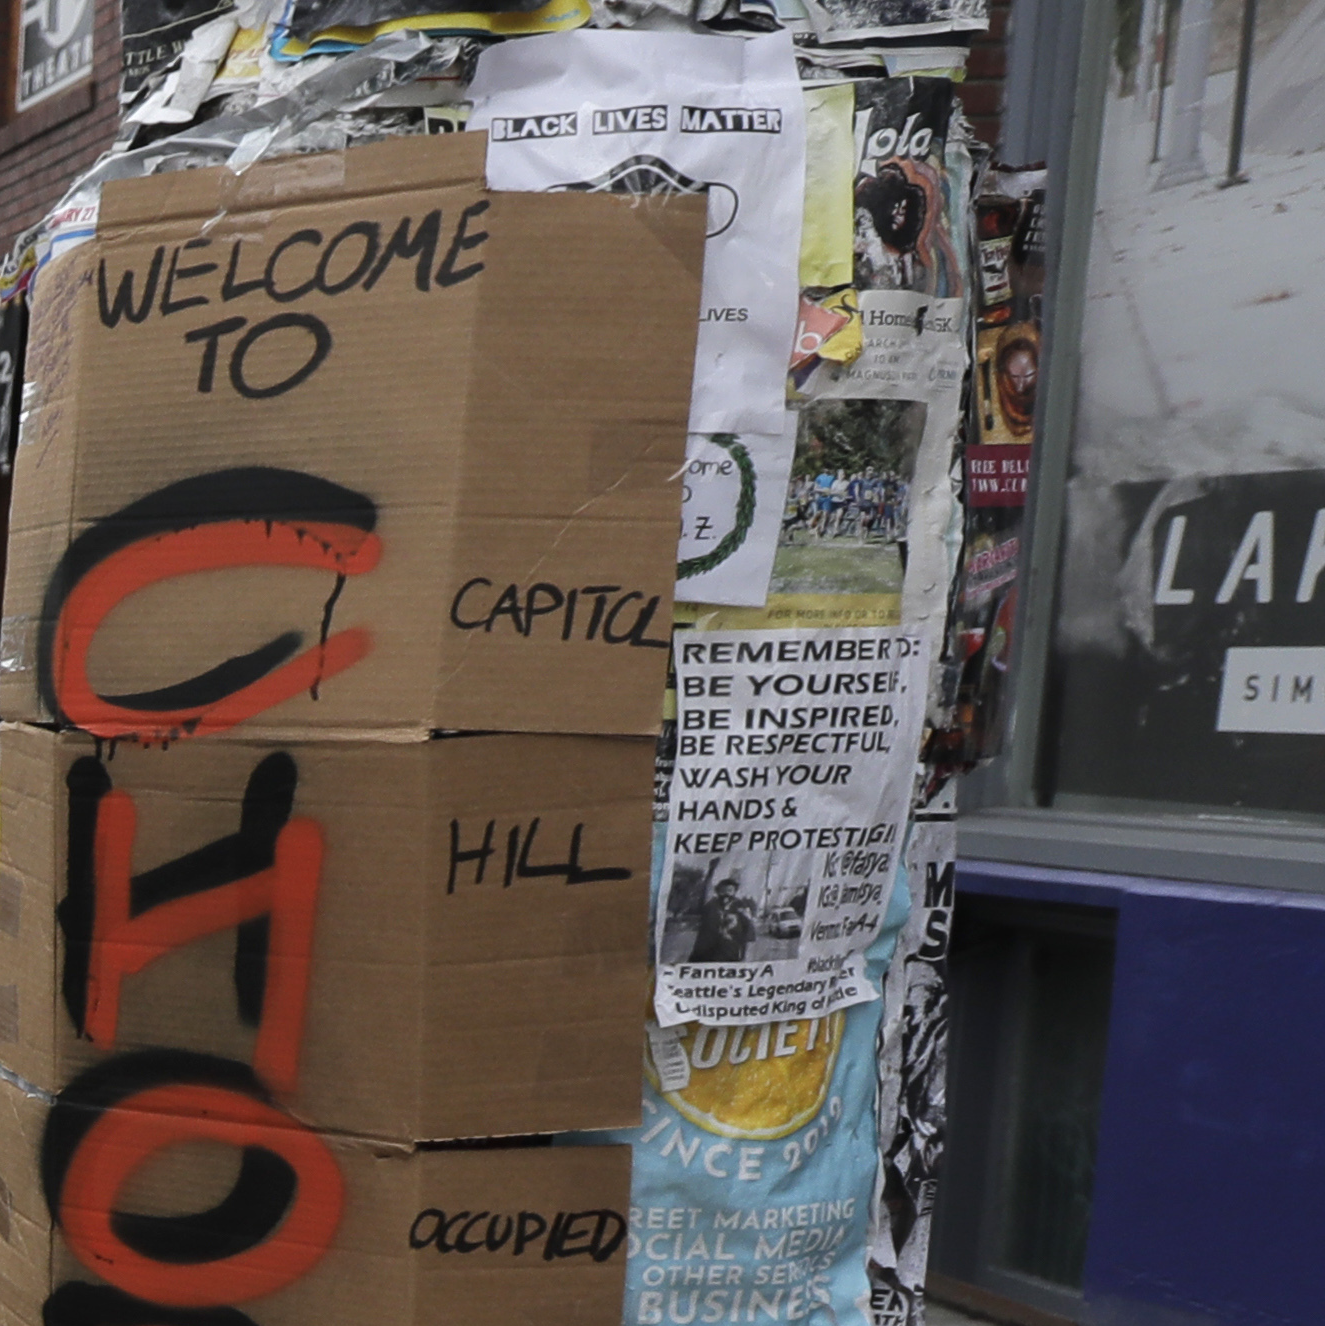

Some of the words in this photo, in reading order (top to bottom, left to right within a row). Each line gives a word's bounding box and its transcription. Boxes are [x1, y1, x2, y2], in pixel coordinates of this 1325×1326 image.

[492, 112, 577, 141] BLACK
[593, 105, 668, 135] LIVES
[680, 106, 781, 133] MATTER
[96, 200, 490, 328] WELCOME
[185, 312, 332, 399] TO
[682, 638, 892, 665] REMEMBER
[683, 676, 734, 698] BE
[682, 708, 732, 731] BE
[744, 704, 900, 730] INSPIRED,
[679, 734, 716, 757] BE
[725, 731, 892, 755] RESPECTFUL,
[679, 766, 769, 789] WASH
[776, 763, 853, 786] YOUR
[676, 797, 776, 822] HANDS
[781, 799, 799, 818] &
[447, 816, 632, 895] HILL
[673, 831, 743, 855] KEEP
[678, 965, 759, 982] Fantasy
[760, 964, 775, 977] A
[748, 979, 828, 1000] Legendary
[675, 1000, 770, 1021] Udisputed
[771, 1000, 807, 1016] King
[640, 1099, 767, 1182] INCE
[629, 1207, 703, 1230] REET
[712, 1197, 856, 1230] MARKETING
[409, 1208, 627, 1262] OCCUPIED
[627, 1231, 736, 1261] OCIAL
[753, 1224, 847, 1261] MEDIA
[642, 1265, 744, 1287] OTHER
